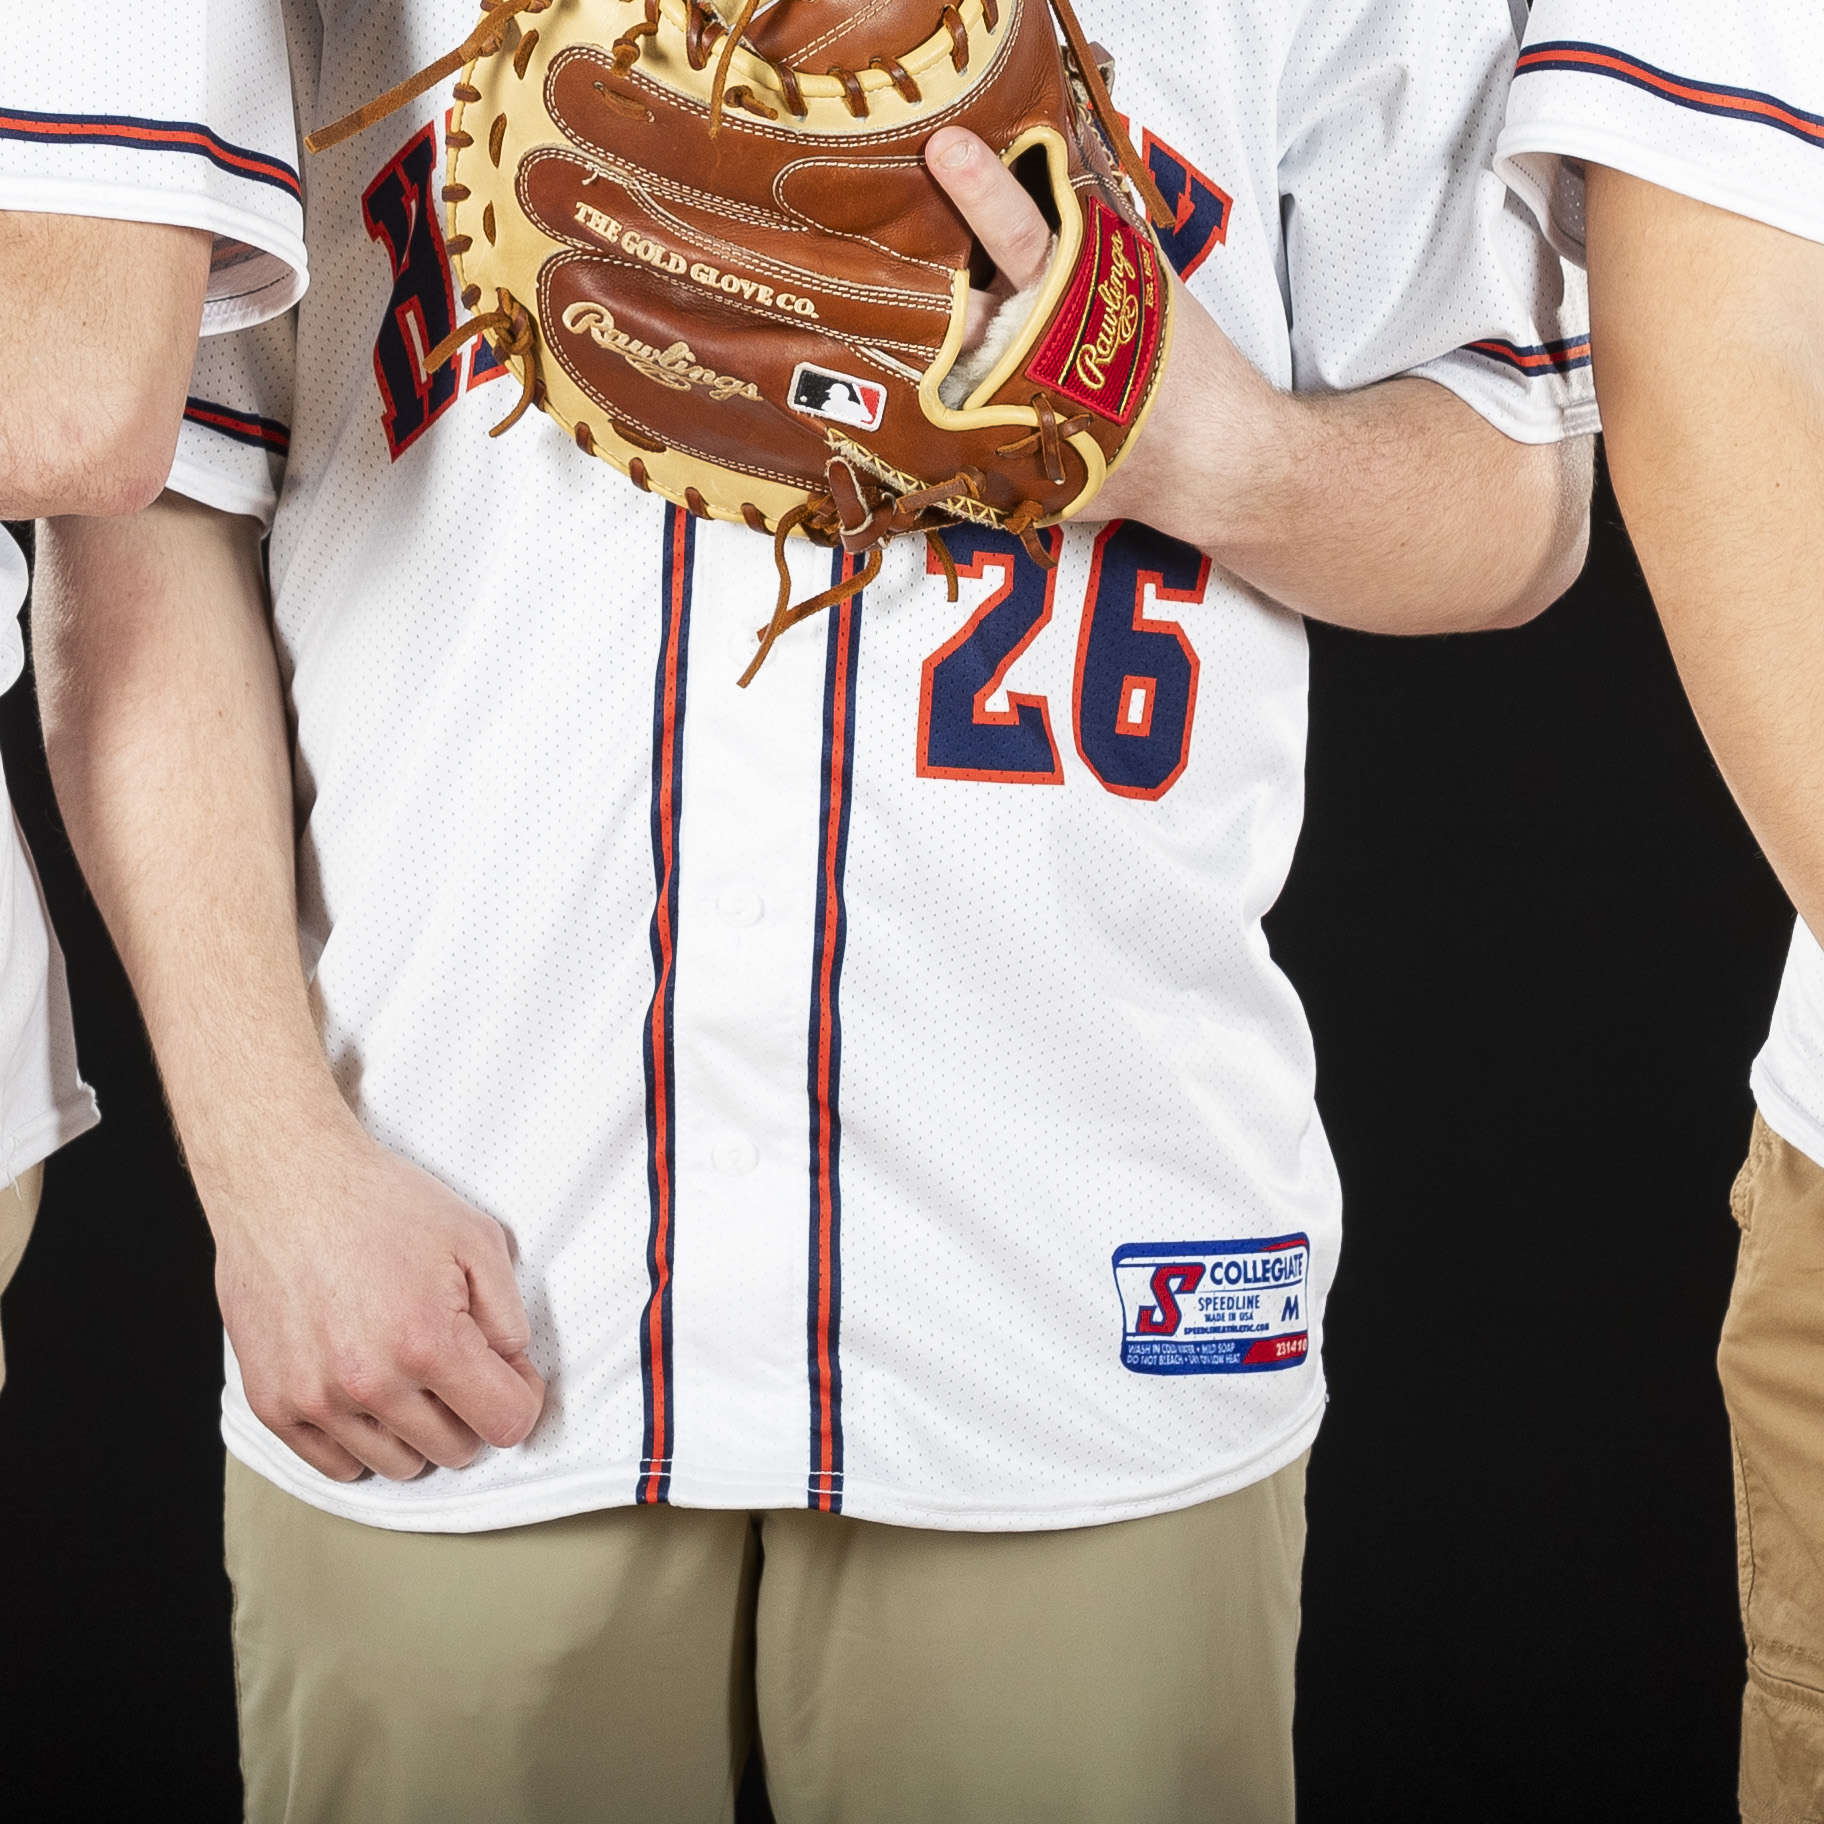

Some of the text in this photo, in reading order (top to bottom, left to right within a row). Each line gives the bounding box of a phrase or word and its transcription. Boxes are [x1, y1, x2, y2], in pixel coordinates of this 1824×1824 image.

[574, 201, 820, 319] THE GOLD GLOVE CO.
[1076, 228, 1139, 390] Rawlings
[562, 301, 765, 402] Rawlings
[916, 520, 1212, 802] 26
[1210, 1252, 1304, 1286] COLLEGIATE
[1198, 1294, 1260, 1312] SPEEDLINE
[1204, 1311, 1254, 1322] MADE IN USA
[1281, 1294, 1300, 1322] M
[1126, 1354, 1140, 1364] DO
[1140, 1354, 1157, 1366] NOT
[1158, 1354, 1184, 1366] BLEACH
[1127, 1343, 1151, 1355] WASH
[1217, 1342, 1236, 1353] SOAP
[1275, 1338, 1308, 1357] 231410
